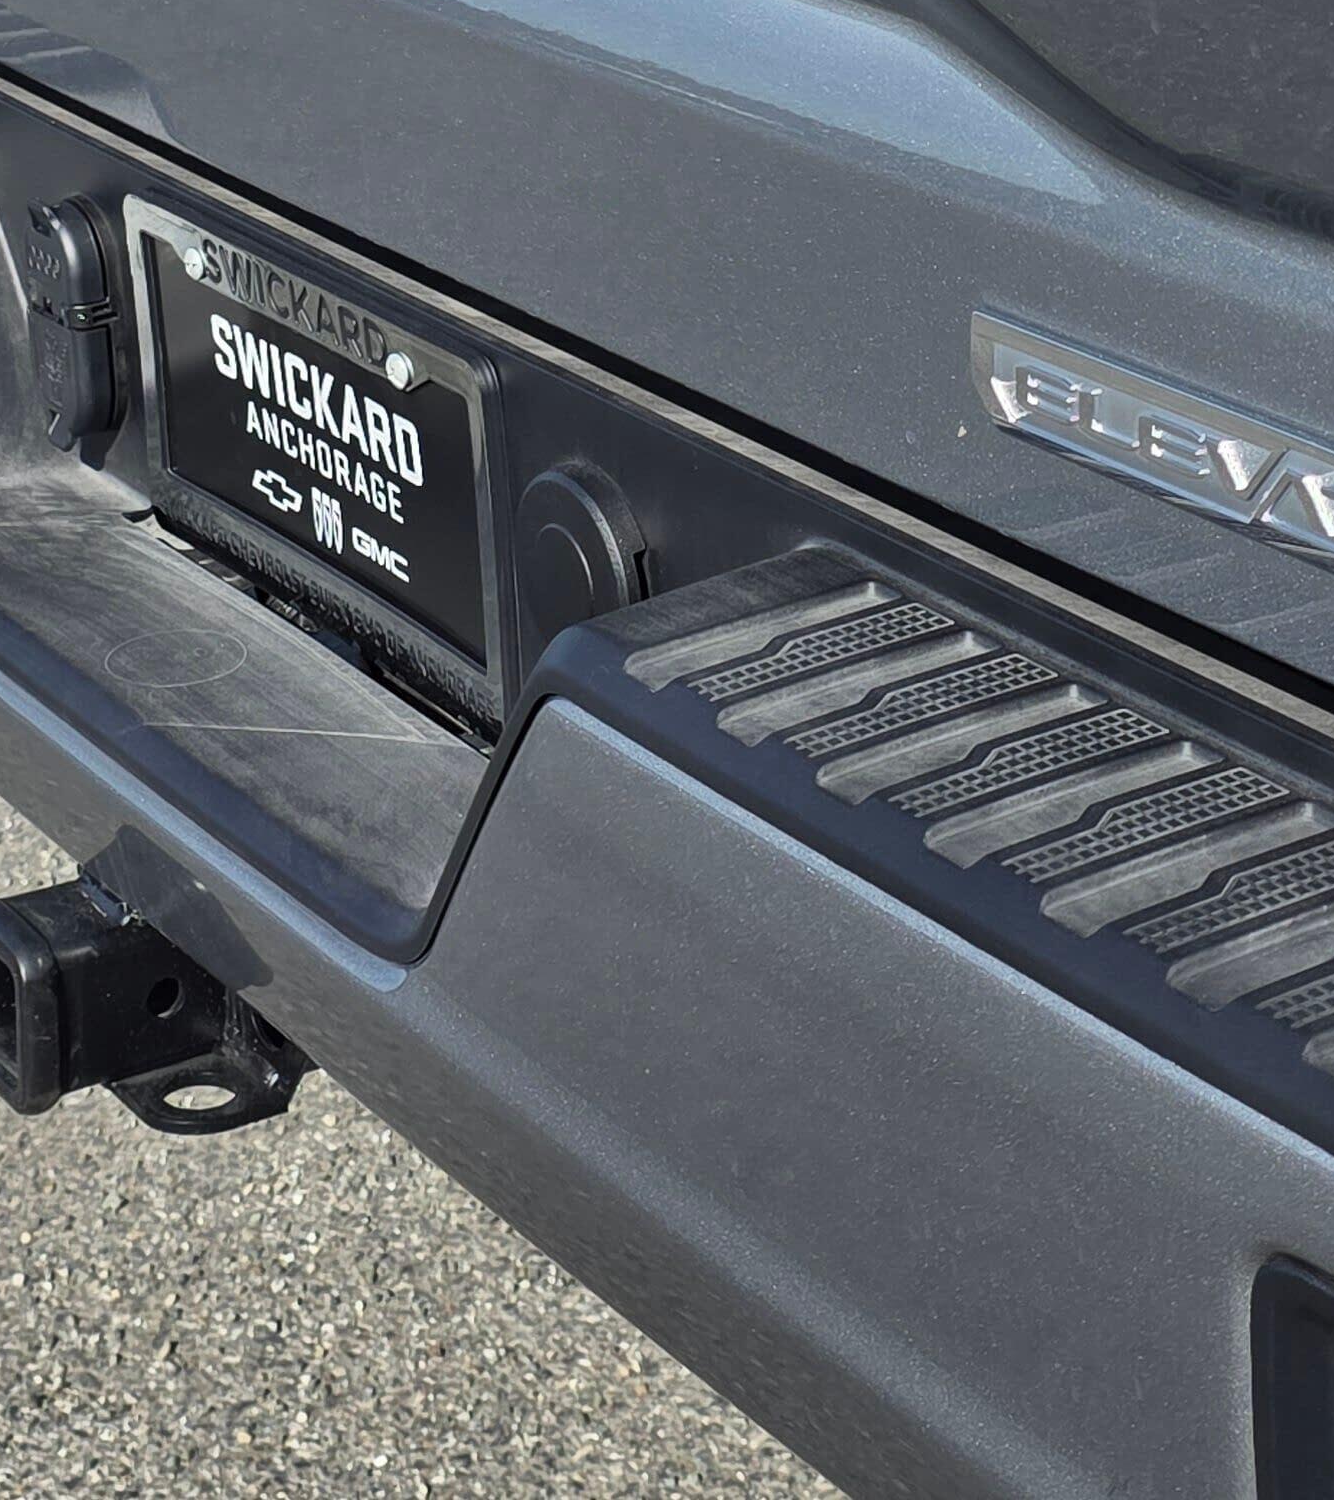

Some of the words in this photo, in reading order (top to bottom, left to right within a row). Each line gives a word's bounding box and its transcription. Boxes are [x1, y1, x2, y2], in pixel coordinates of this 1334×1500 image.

[201, 238, 388, 366] SWICKARD
[210, 314, 423, 486] SWICKARD
[246, 401, 404, 524] ANCHORAGE
[352, 527, 409, 582] GMC
